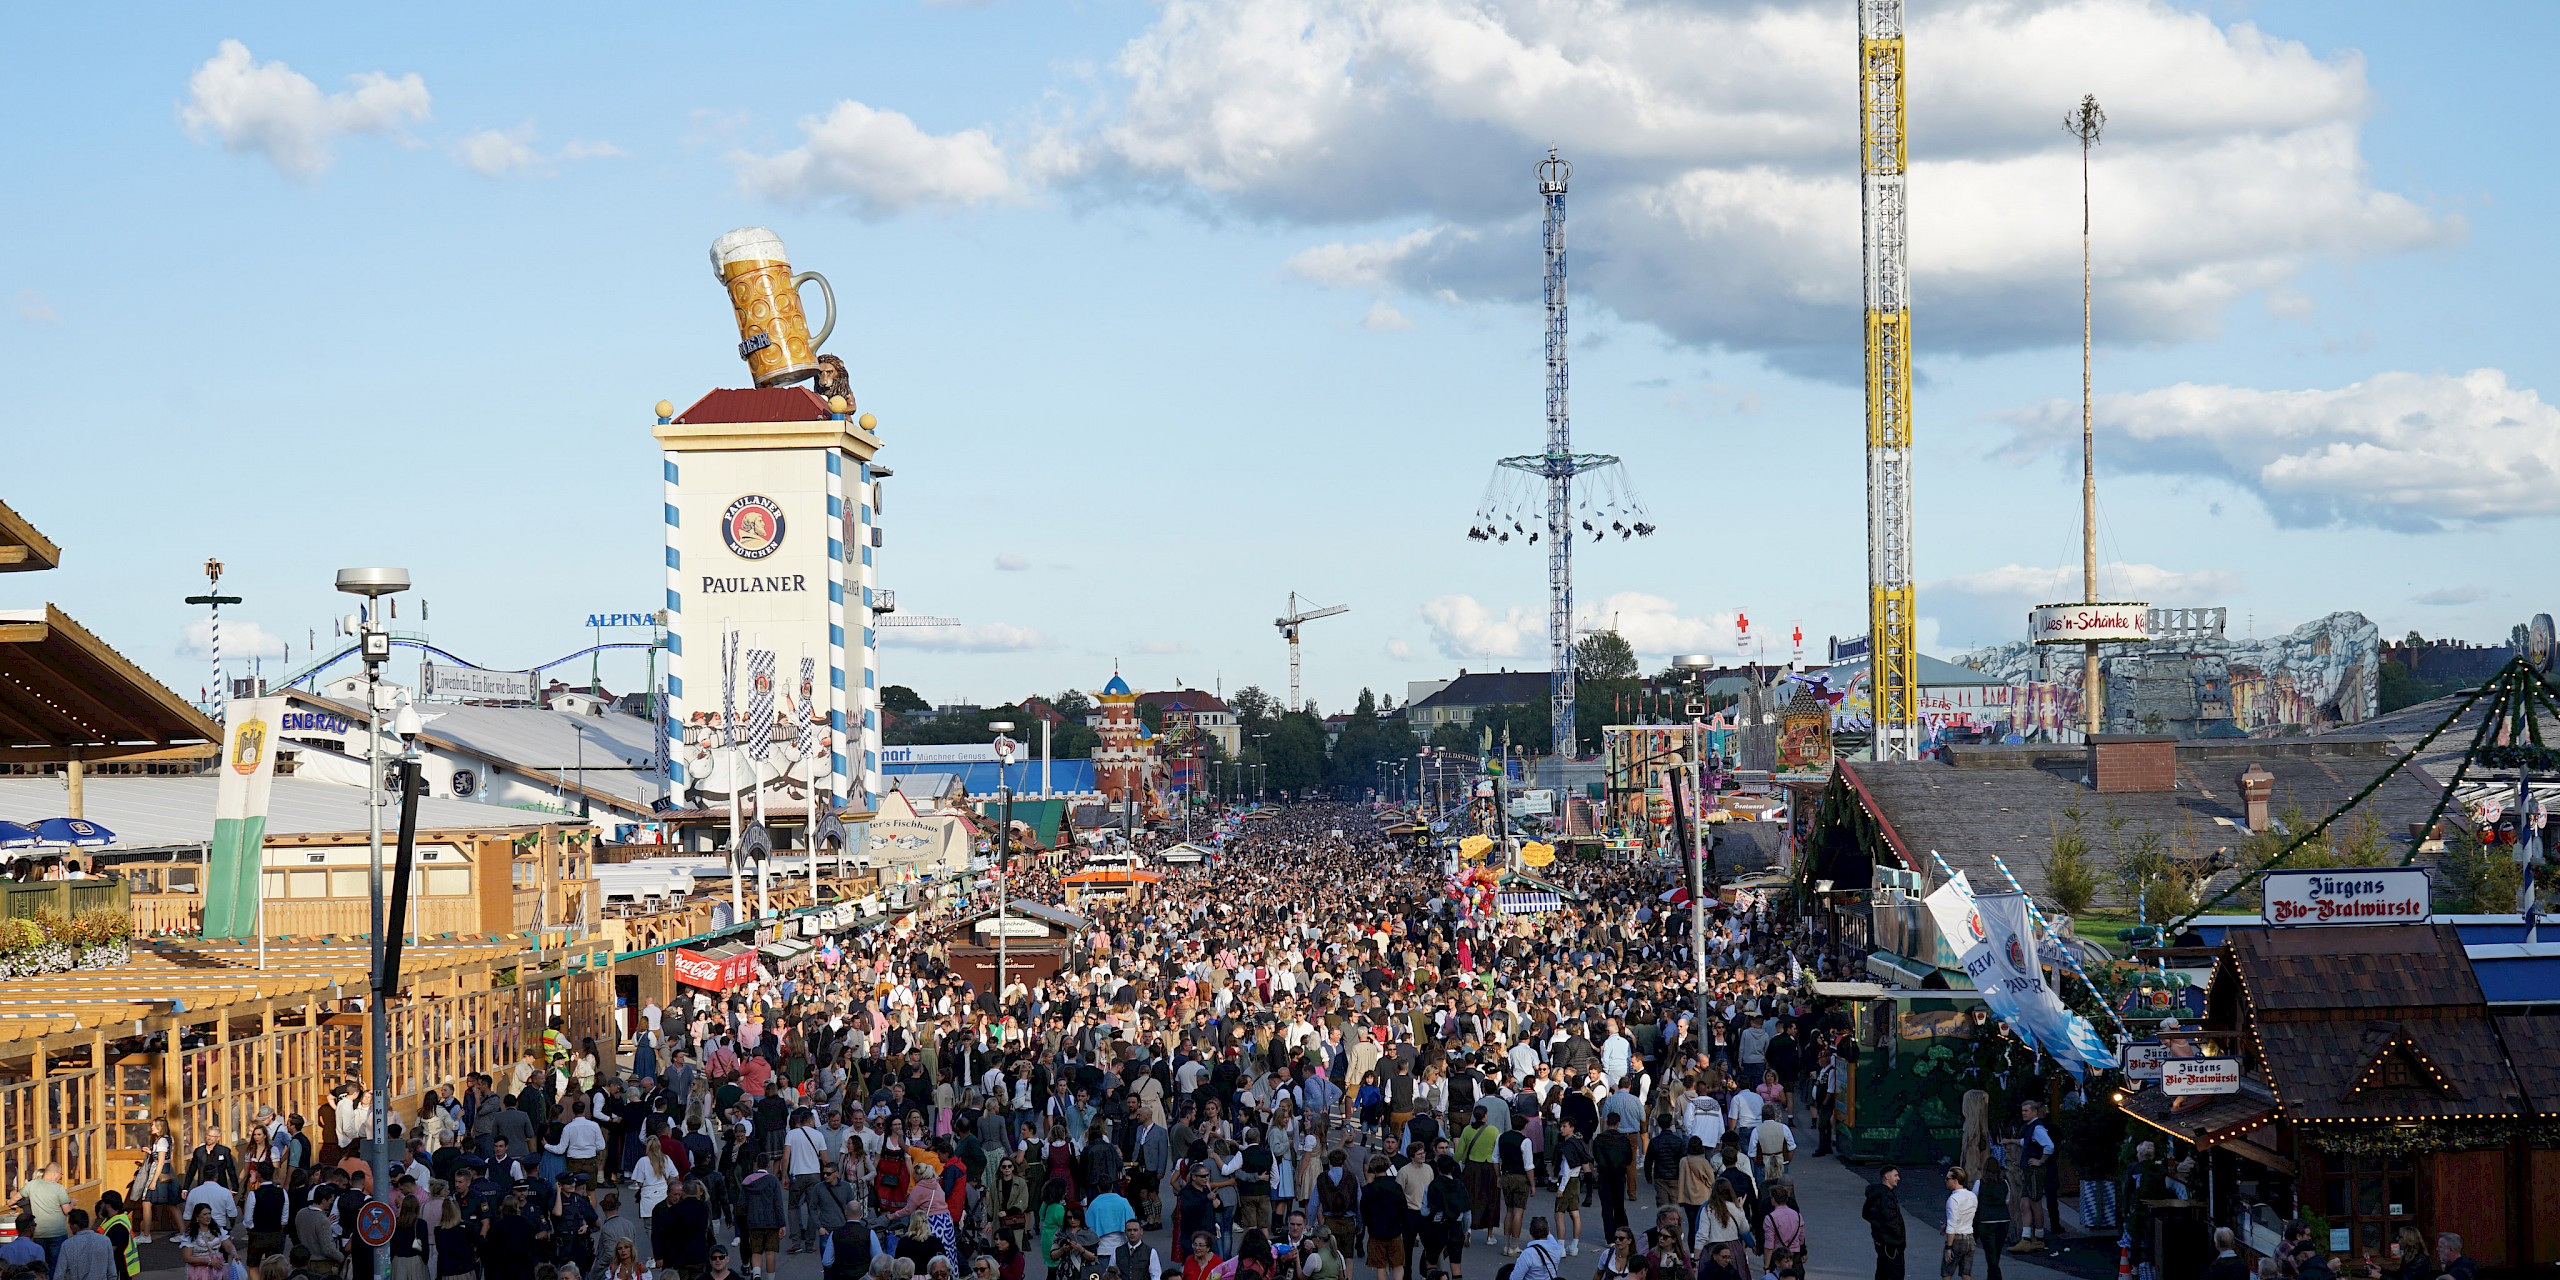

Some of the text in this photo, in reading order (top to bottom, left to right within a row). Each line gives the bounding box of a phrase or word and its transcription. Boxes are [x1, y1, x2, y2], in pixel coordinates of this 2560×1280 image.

[724, 496, 782, 521] PAULANER
[702, 574, 807, 593] PAULANER
[586, 614, 654, 627] ALPINA
[2147, 608, 2226, 639] BLITZ
[436, 671, 527, 700] Löwenbräu. Ein Bier wie Bayern.
[282, 713, 350, 735] ENBRÄU
[916, 753, 955, 761] Münchner
[958, 752, 986, 760] Genuss
[893, 820, 938, 833] Fischhaus
[1084, 864, 1107, 872] Heisse
[2309, 876, 2385, 899] Jürgens
[2273, 898, 2420, 922] Bio-Bratwürste
[2143, 1048, 2171, 1059] Jürg
[2179, 1063, 2221, 1074] Jürgens
[2164, 1072, 2237, 1086] Bio-Bratwürste
